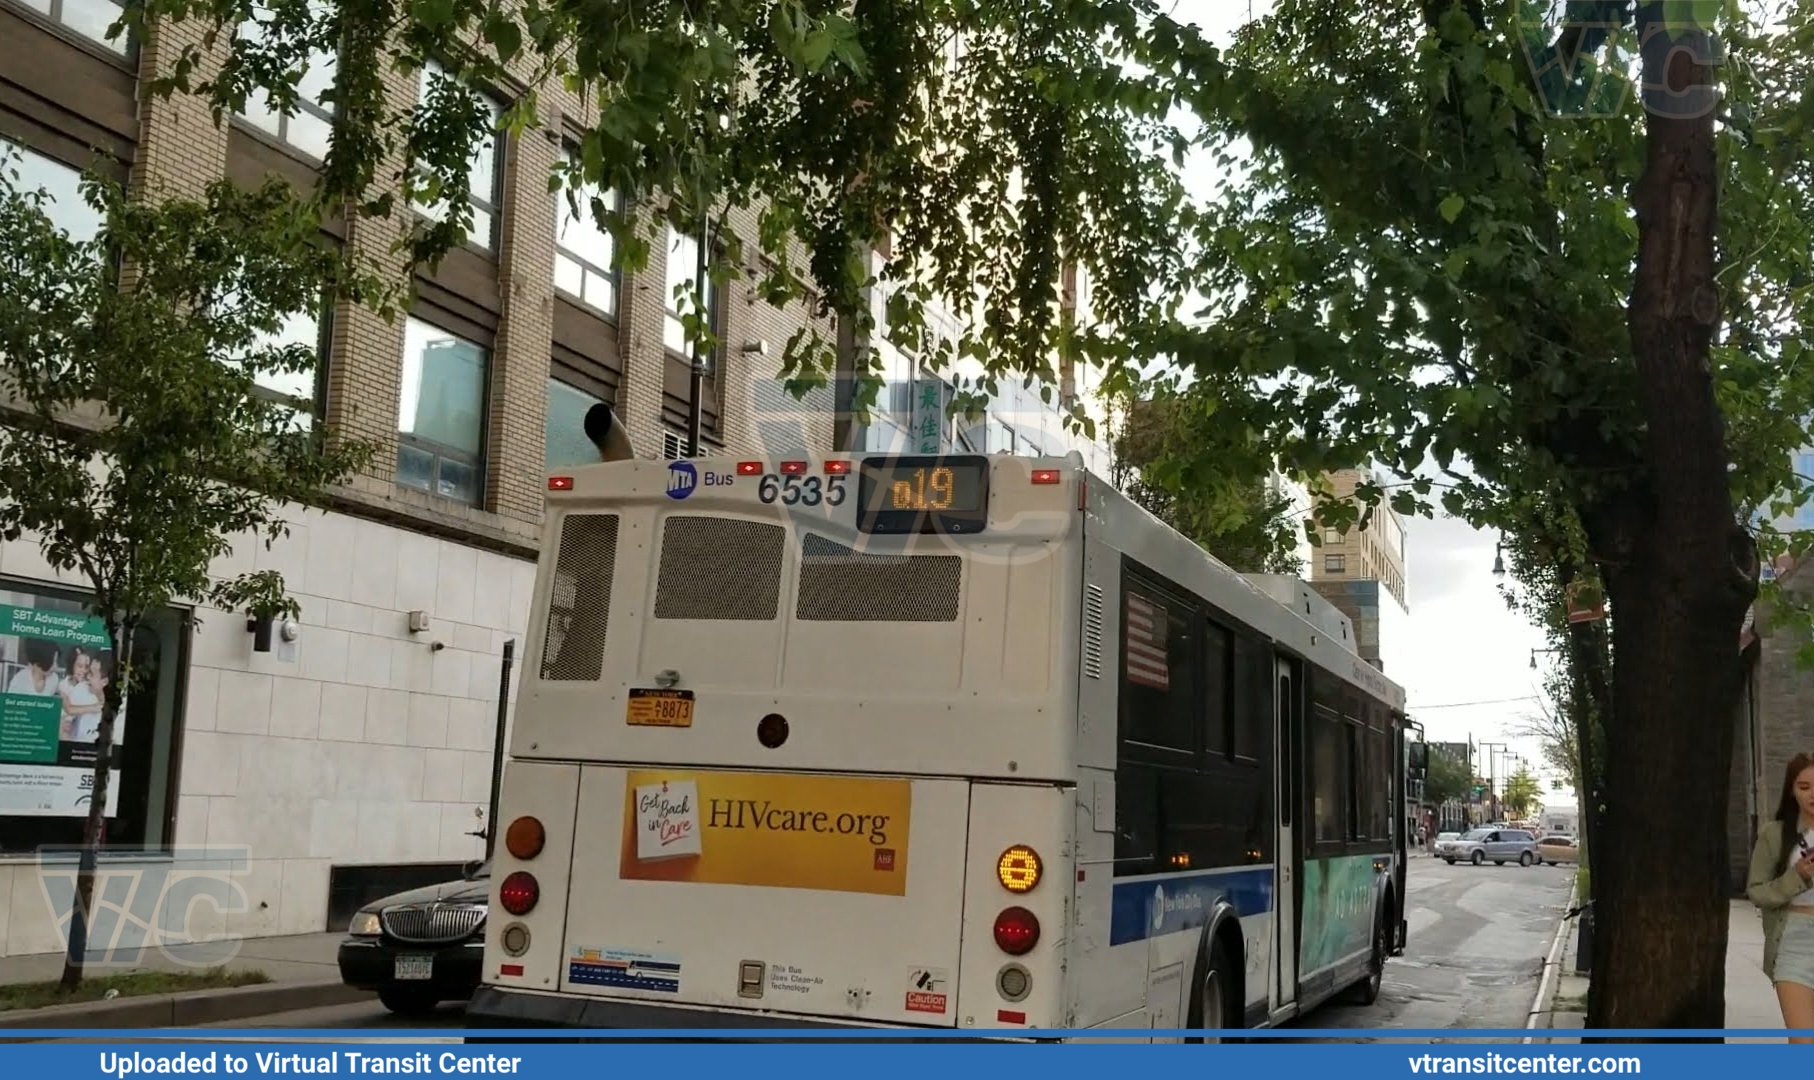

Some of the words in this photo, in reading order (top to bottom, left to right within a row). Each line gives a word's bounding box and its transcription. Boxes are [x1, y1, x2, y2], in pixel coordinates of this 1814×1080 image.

[704, 471, 734, 486] Bus
[758, 473, 847, 507] 6535
[13, 609, 34, 621] SBT
[11, 621, 41, 635] Home
[42, 626, 65, 638] Loan
[66, 629, 105, 644] Program
[80, 774, 95, 787] SB
[640, 793, 660, 813] Get
[658, 795, 690, 819] Back
[708, 799, 890, 845] HIVcare.org
[648, 819, 661, 831] in
[660, 819, 693, 841] Care
[877, 854, 892, 864] AHF
[772, 964, 786, 973] This
[788, 966, 802, 974] Bus
[771, 974, 788, 982] Uses
[791, 975, 824, 985] Clean-Air
[771, 982, 810, 993] Technology
[908, 993, 945, 1005] Caution
